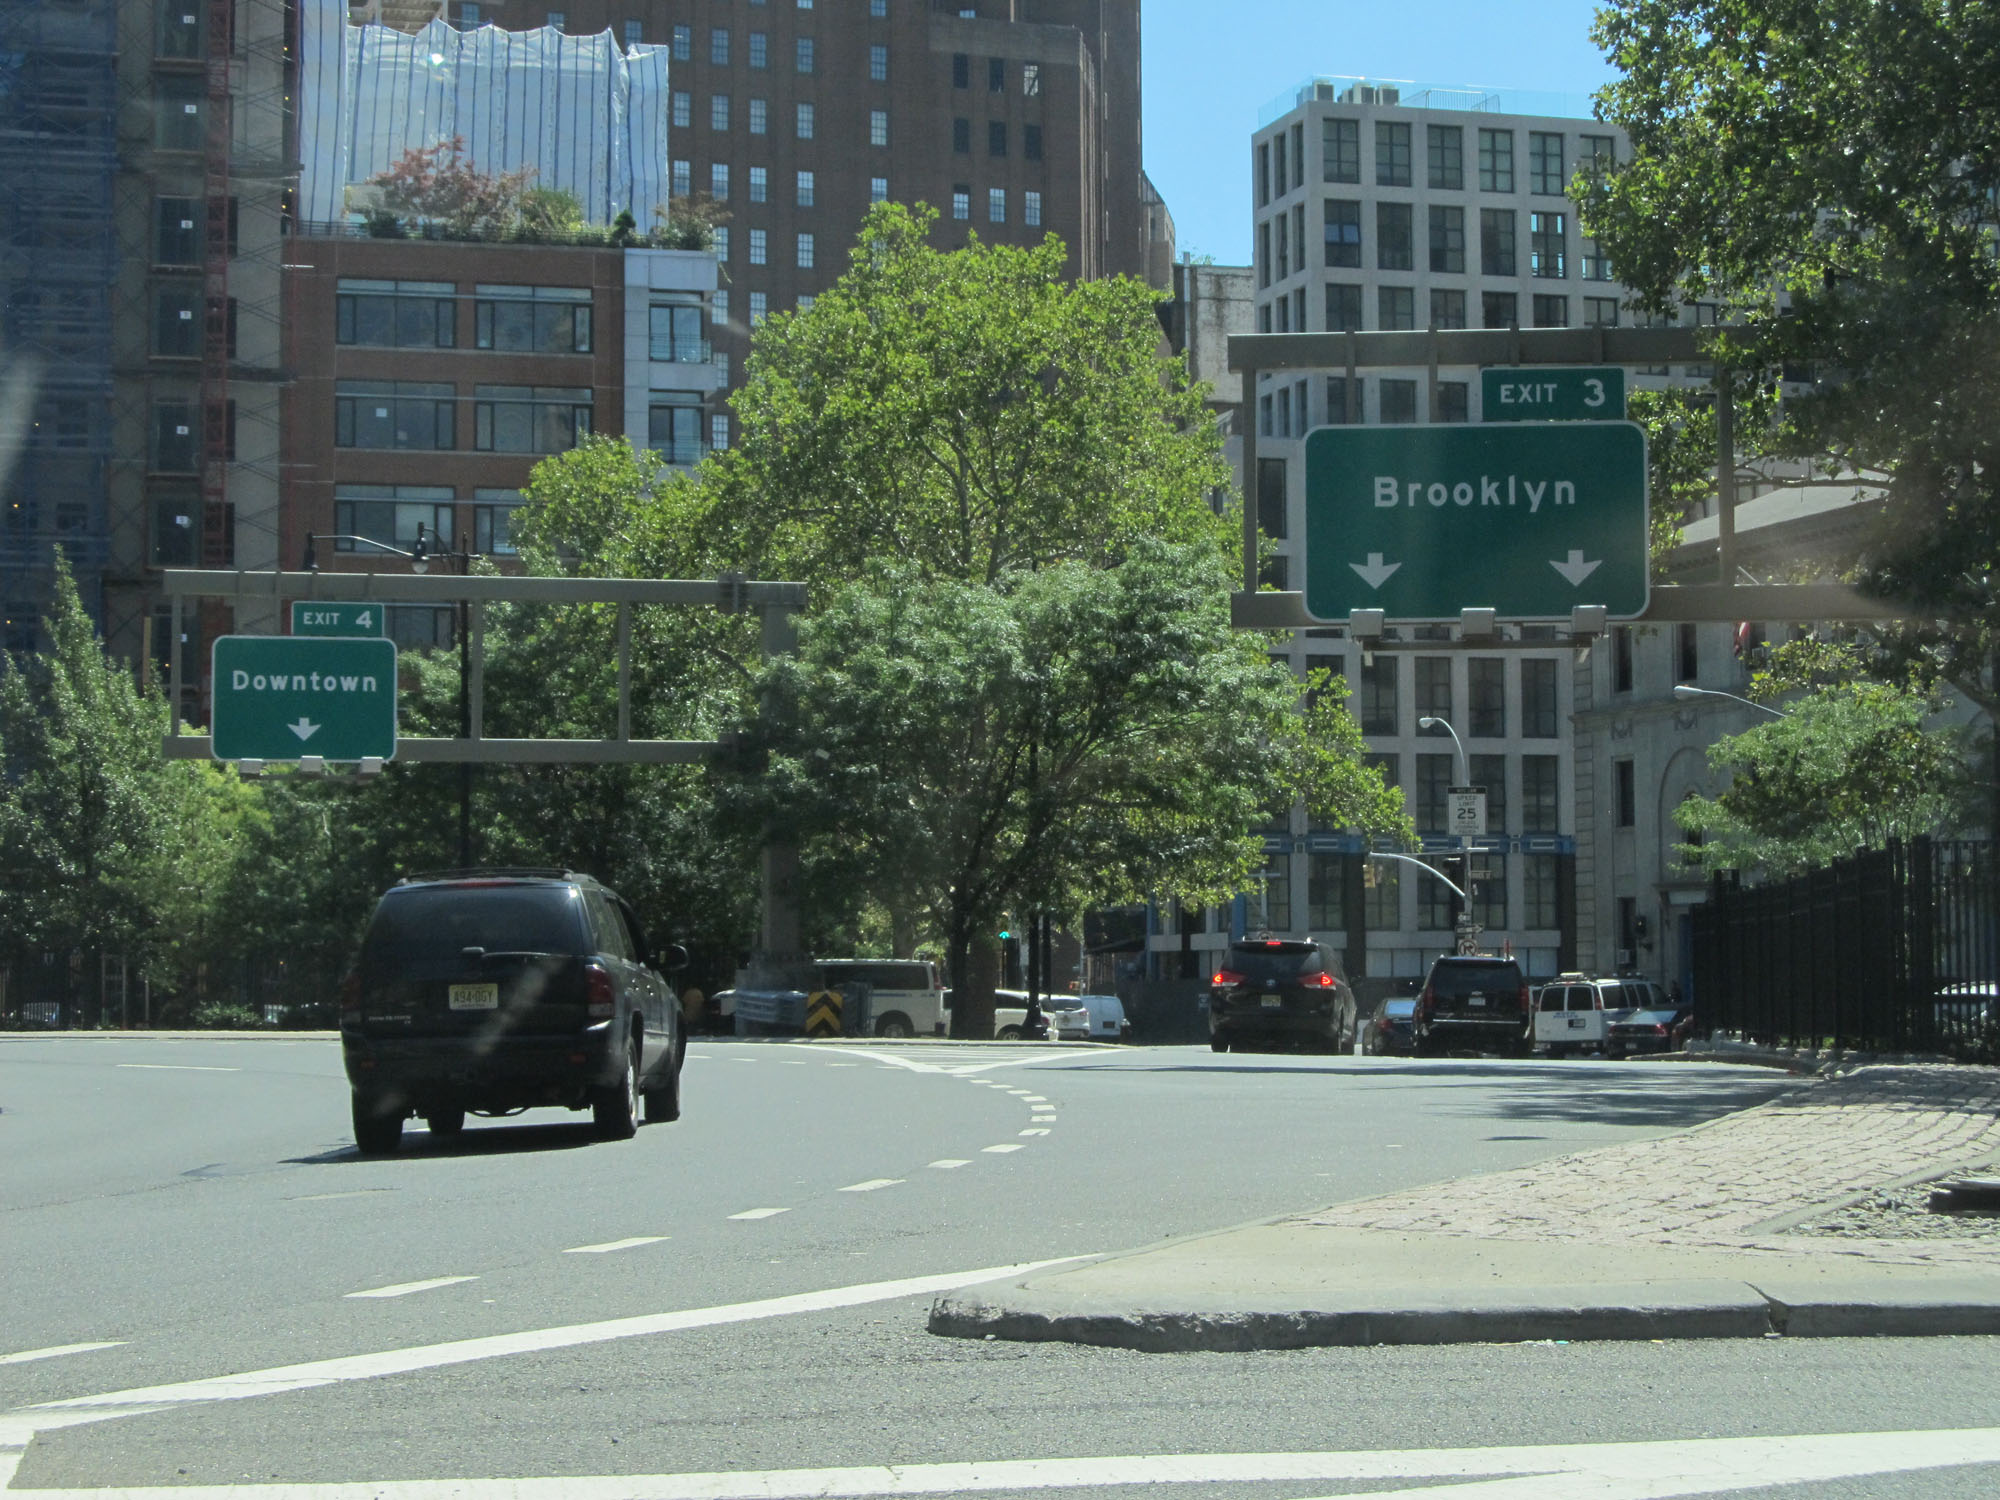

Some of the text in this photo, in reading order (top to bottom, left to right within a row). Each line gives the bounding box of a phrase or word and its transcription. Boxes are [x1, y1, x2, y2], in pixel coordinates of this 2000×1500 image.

[1500, 378, 1605, 407] EXIT 3
[1373, 475, 1576, 513] Brooklyn
[303, 610, 372, 628] EXIT 4
[232, 670, 377, 692] Downtown
[1457, 808, 1476, 820] 25
